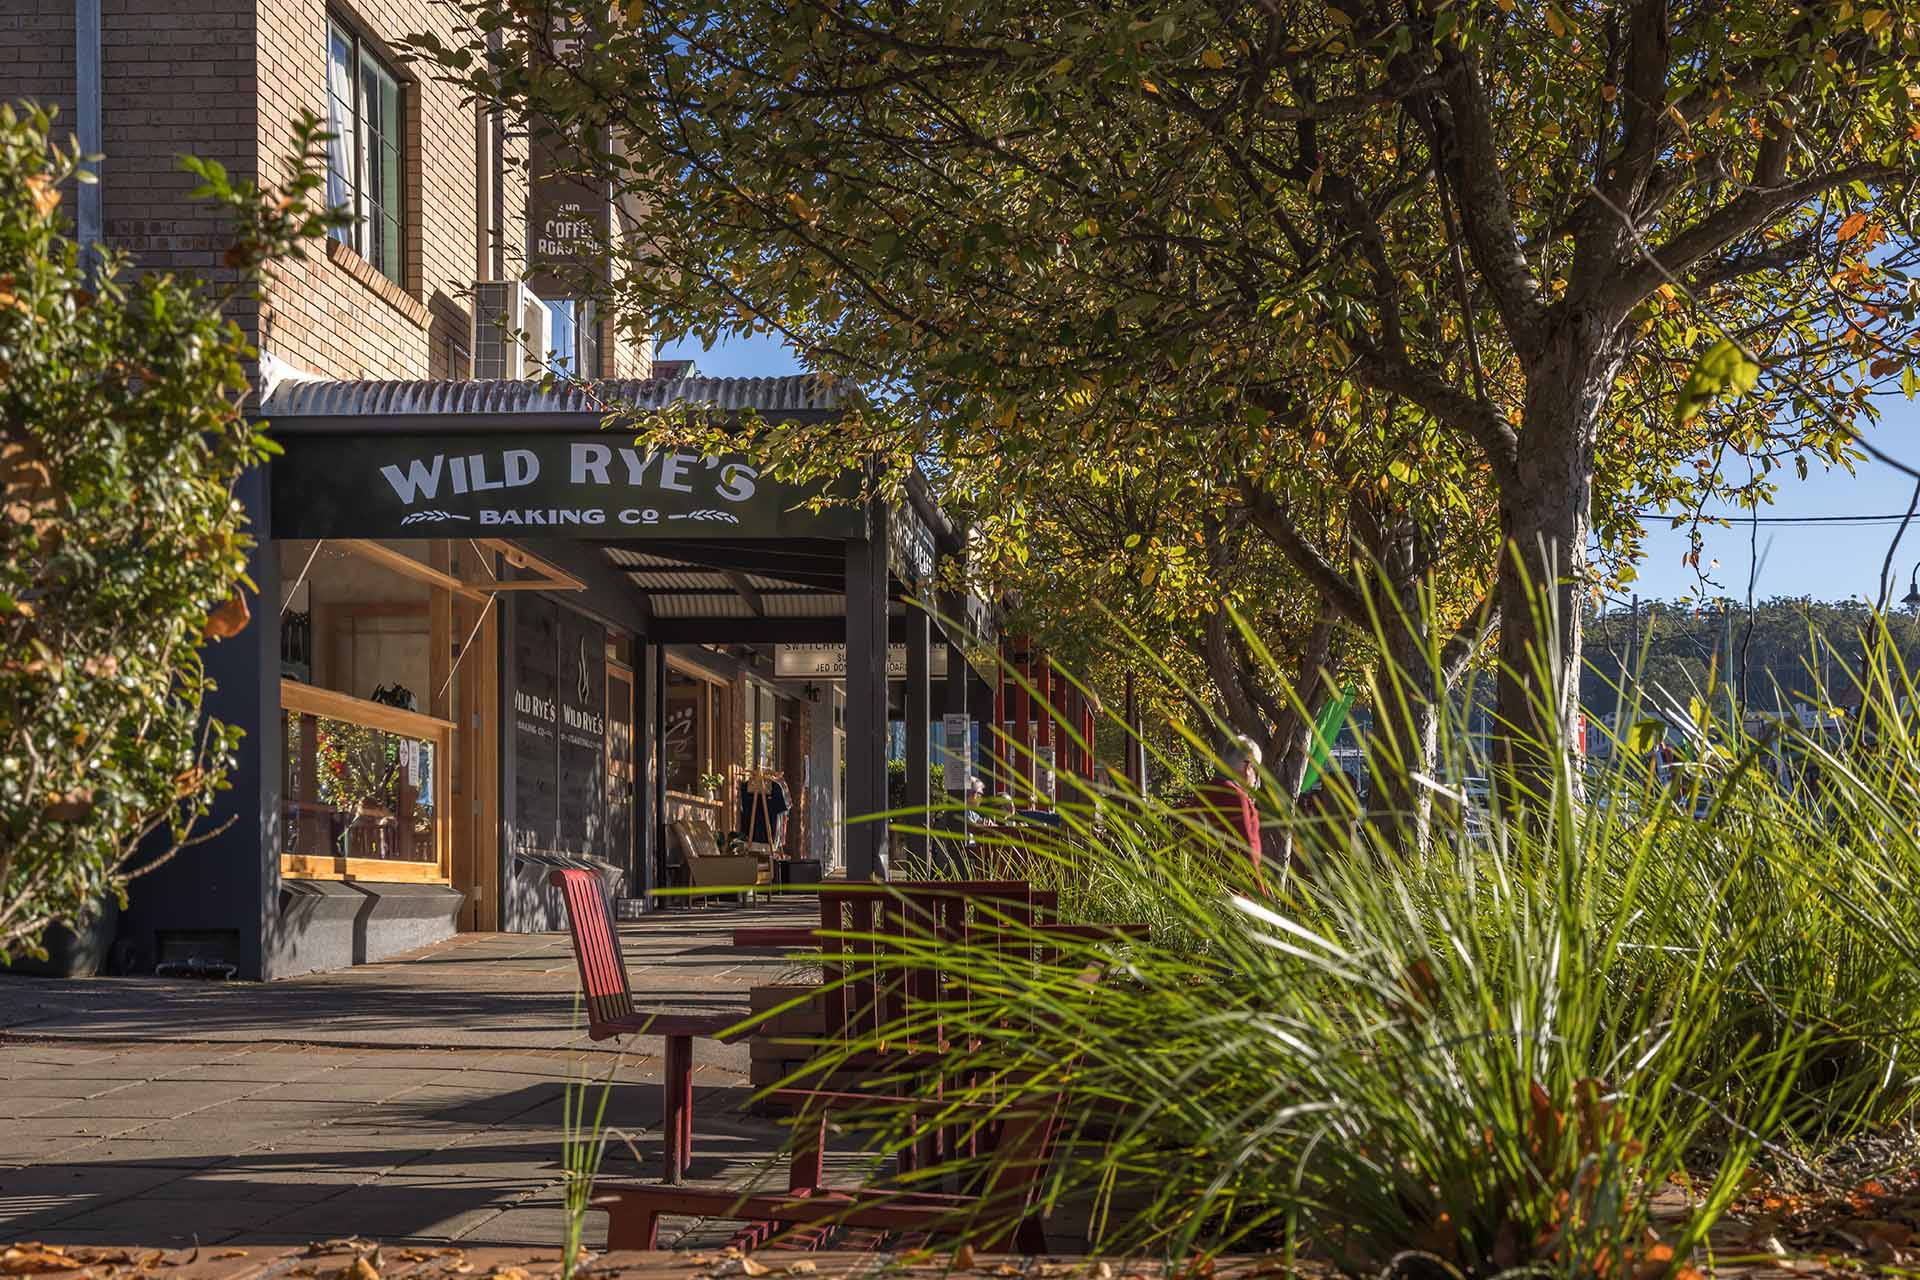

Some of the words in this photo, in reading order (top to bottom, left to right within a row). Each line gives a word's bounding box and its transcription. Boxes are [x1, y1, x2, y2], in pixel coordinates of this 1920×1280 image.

[379, 449, 540, 505] WILD
[570, 442, 759, 502] RYE'S
[479, 509, 606, 525] BAKING
[532, 695, 556, 723] RYE'S
[563, 703, 582, 729] WILD
[582, 711, 603, 735] RYE'S
